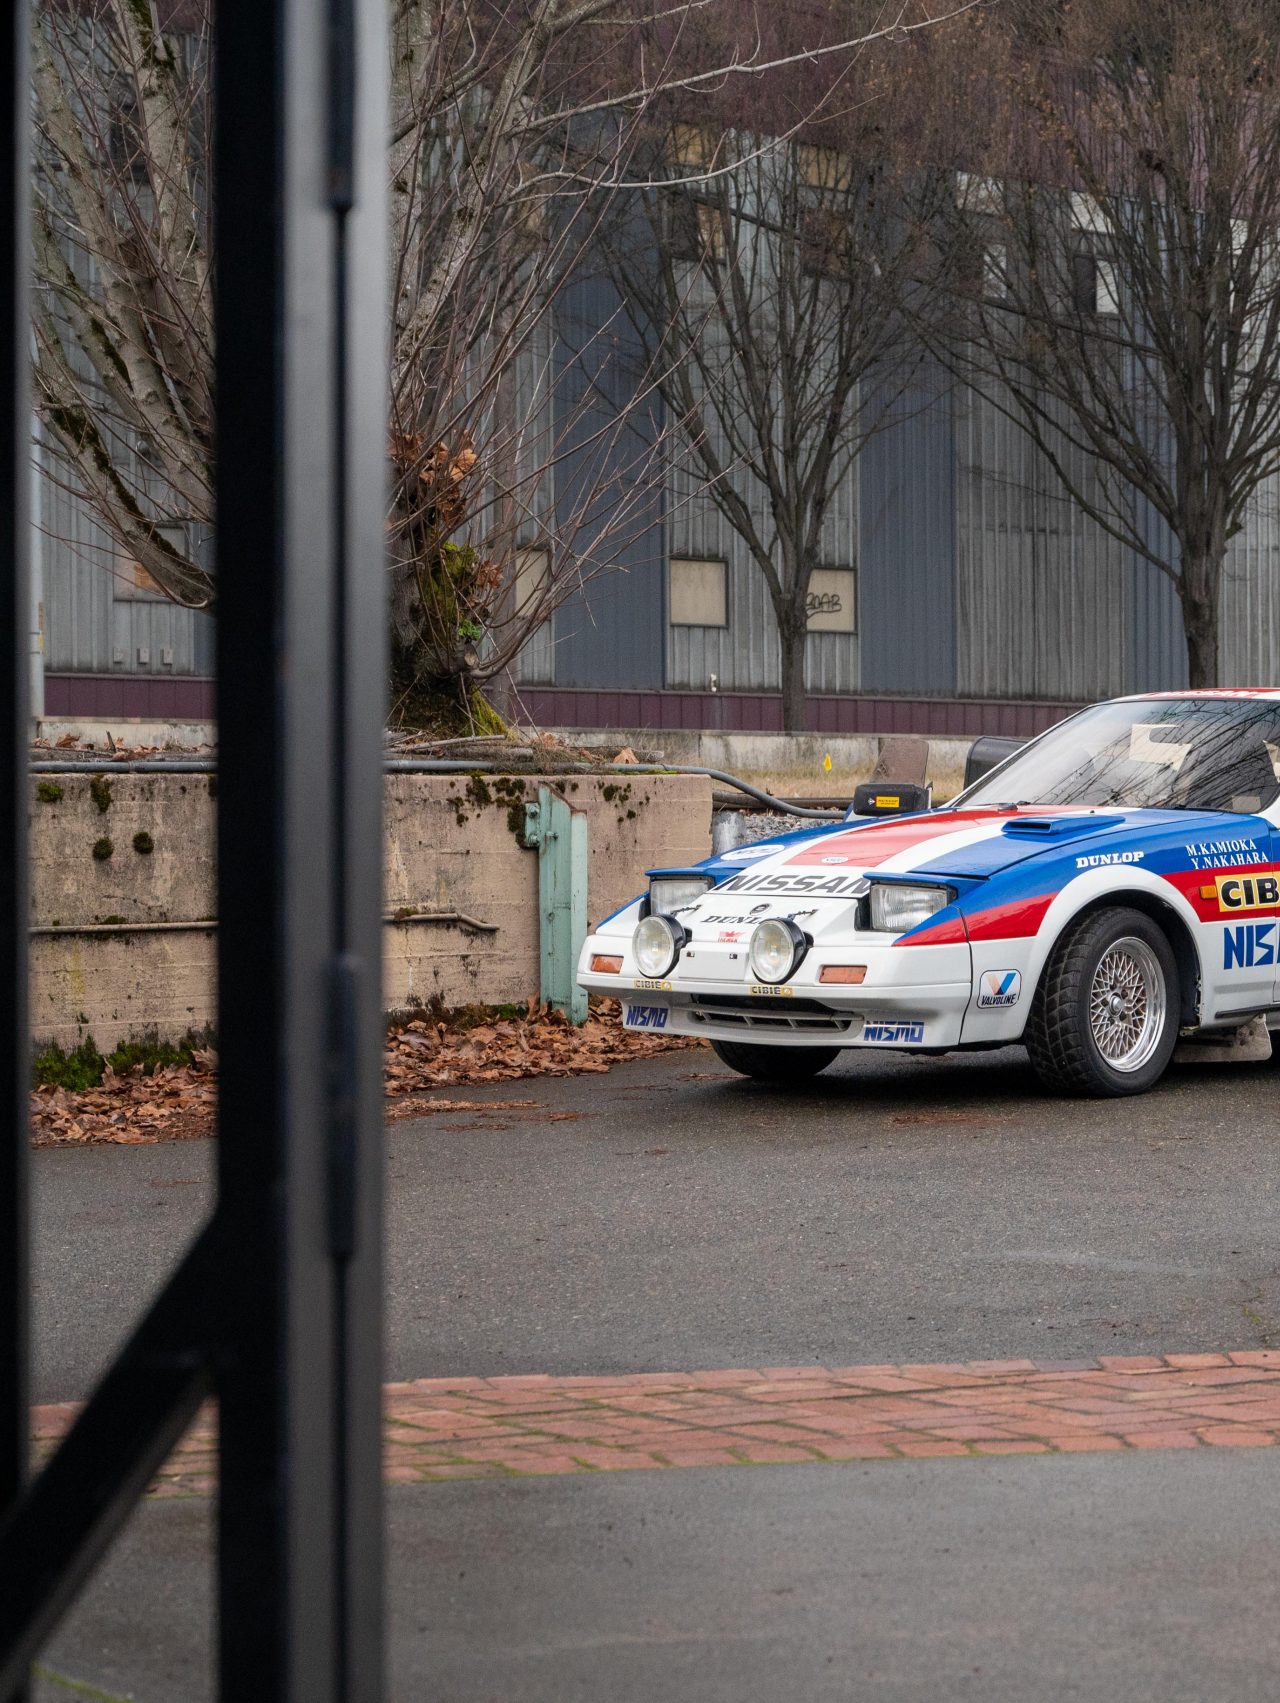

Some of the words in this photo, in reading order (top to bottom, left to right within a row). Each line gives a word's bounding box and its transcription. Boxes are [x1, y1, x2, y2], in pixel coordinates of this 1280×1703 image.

[1185, 838, 1257, 857] M.KAMIOKA
[1076, 851, 1145, 869] DUNLOP
[1191, 851, 1269, 870] Y.NAKAHARA
[713, 875, 871, 894] NISSAN
[700, 915, 761, 924] DUNL
[980, 993, 1017, 1006] VALVOLINE
[625, 1005, 669, 1028] NISMO
[863, 1020, 925, 1043] NISMO
